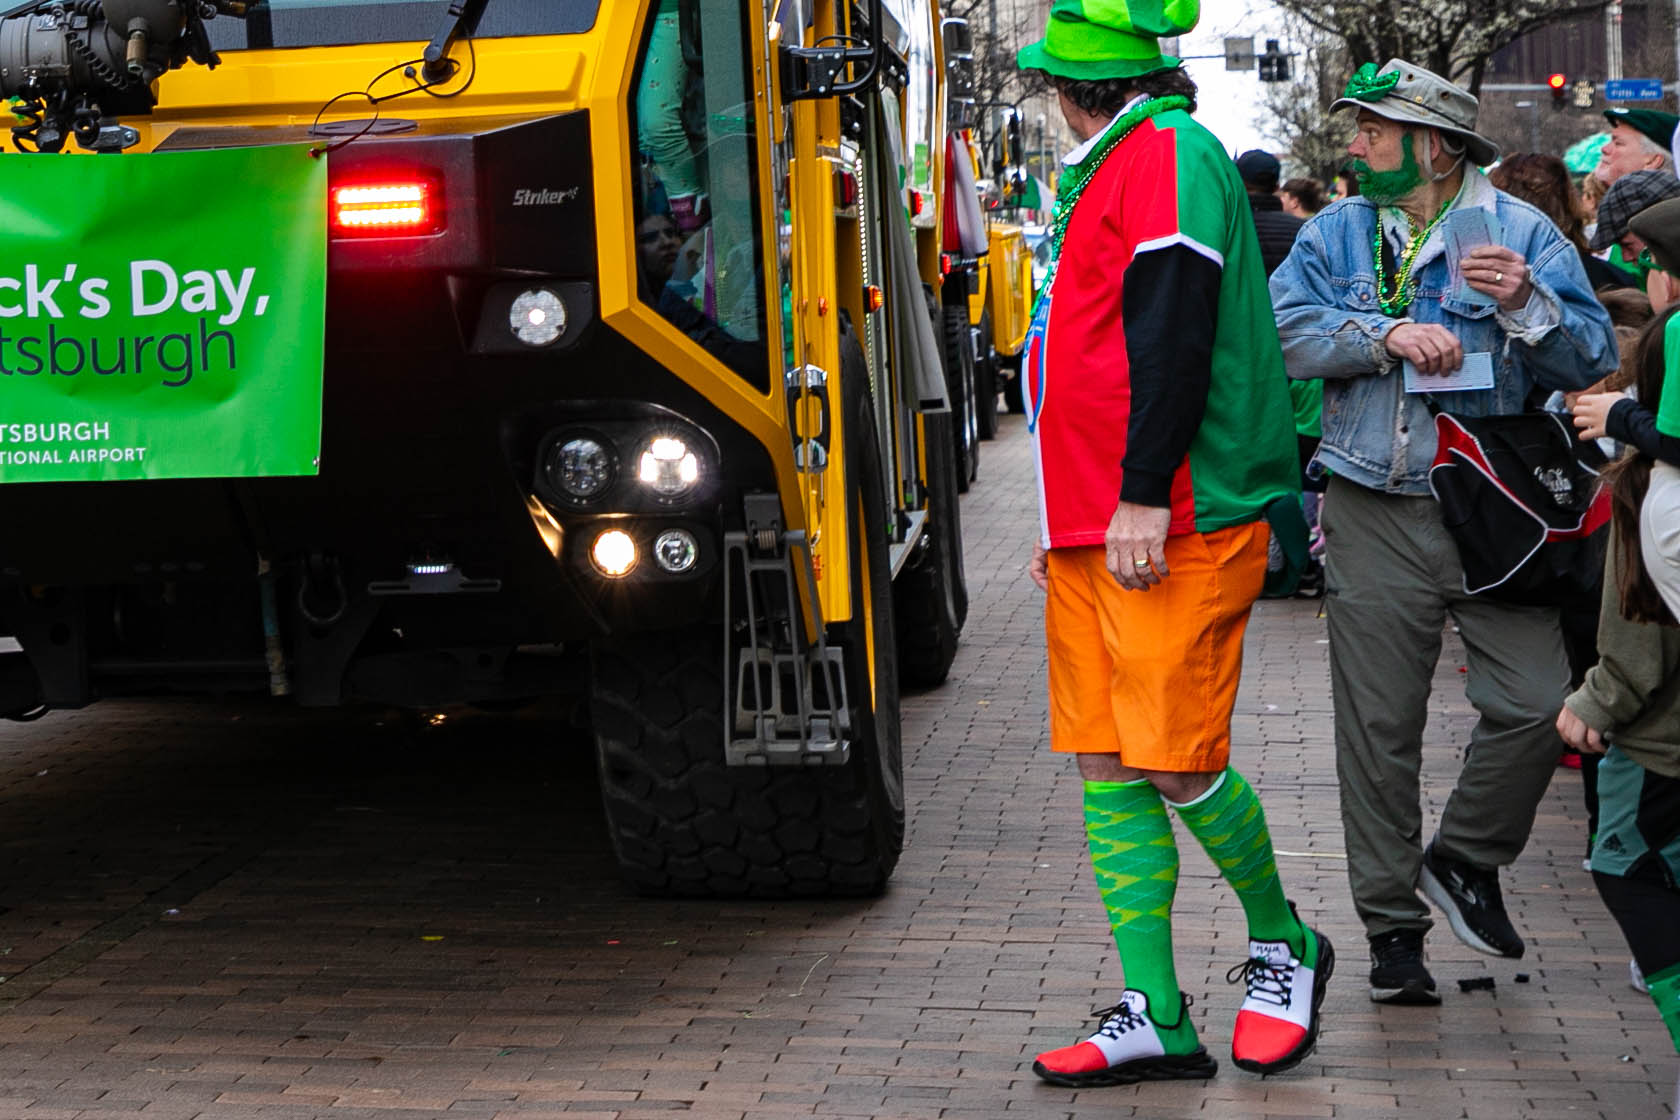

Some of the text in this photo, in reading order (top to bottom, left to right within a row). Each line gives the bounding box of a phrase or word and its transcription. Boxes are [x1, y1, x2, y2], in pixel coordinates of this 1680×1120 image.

[512, 187, 567, 206] Striker
[130, 259, 270, 326] Day,
[68, 447, 147, 463] AIRPORT
